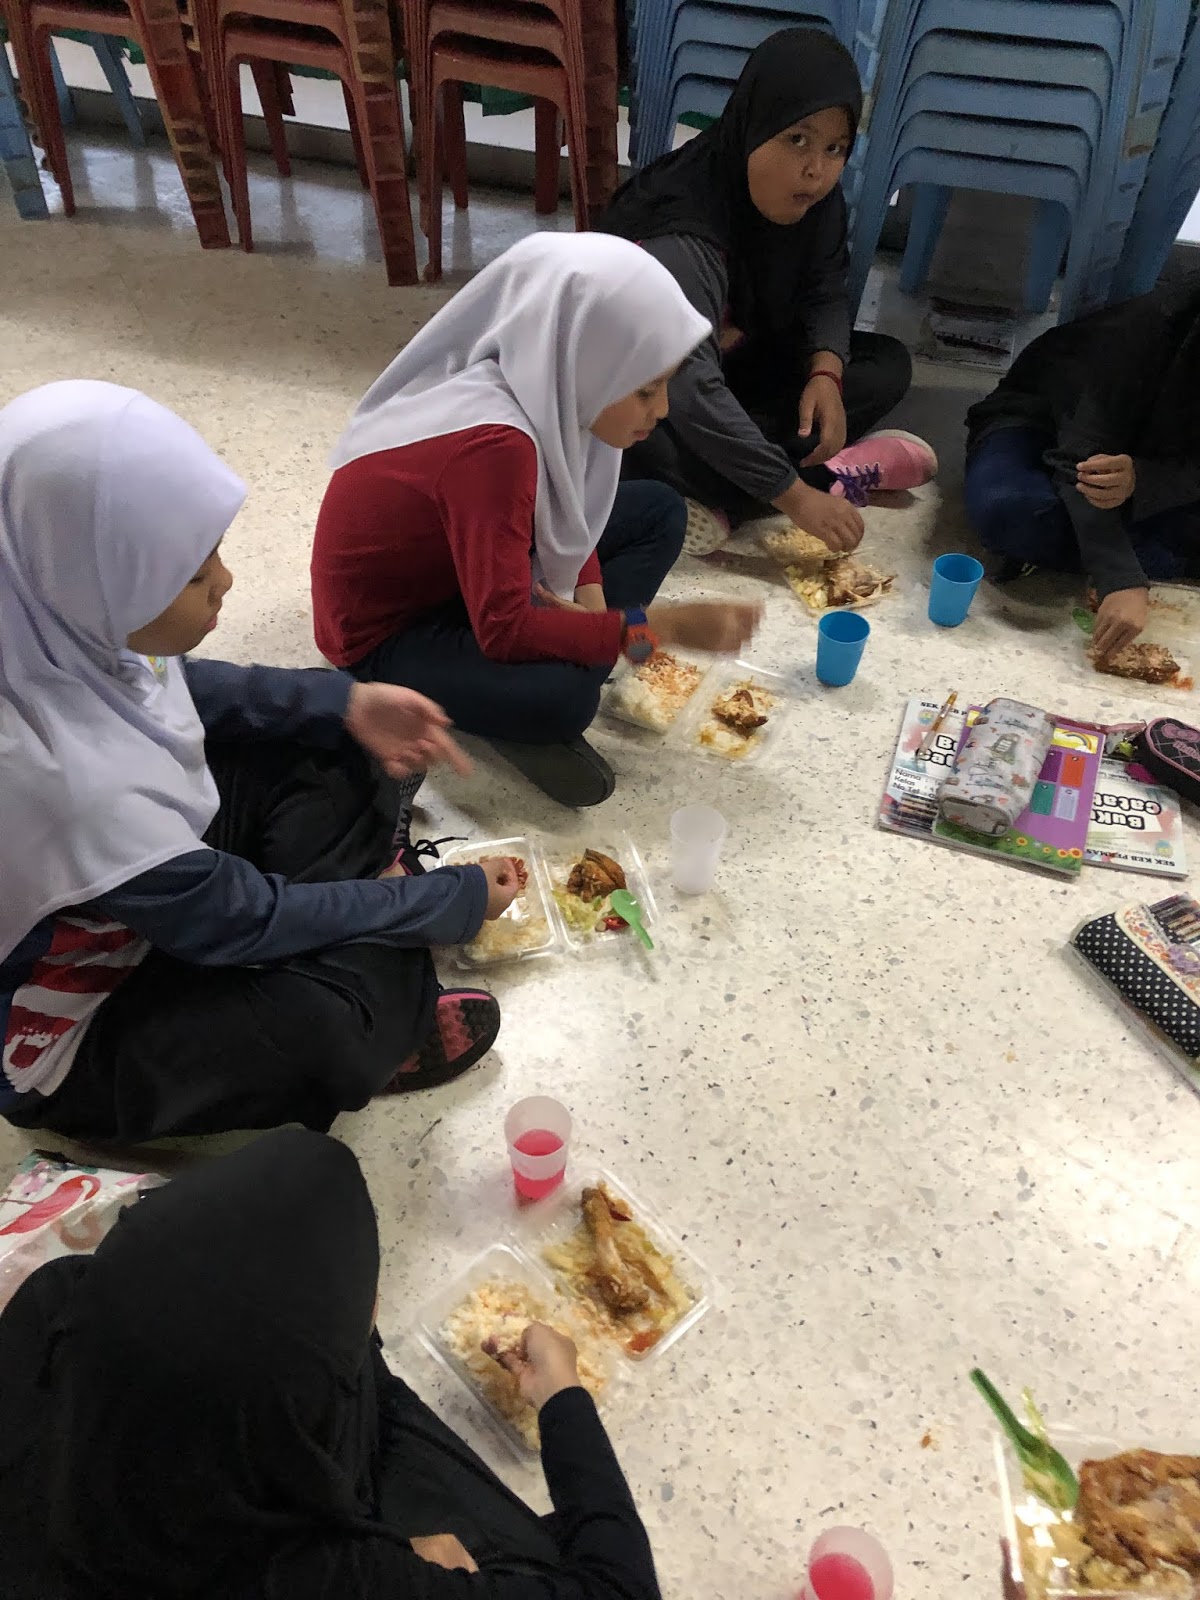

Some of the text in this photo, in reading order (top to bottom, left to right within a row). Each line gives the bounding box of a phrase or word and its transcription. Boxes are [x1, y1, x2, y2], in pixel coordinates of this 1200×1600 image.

[920, 701, 939, 709] SEK
[895, 768, 921, 781] Nama
[894, 775, 916, 786] Kelas
[1086, 848, 1128, 859] PERMAS
[1131, 855, 1152, 864] KEB
